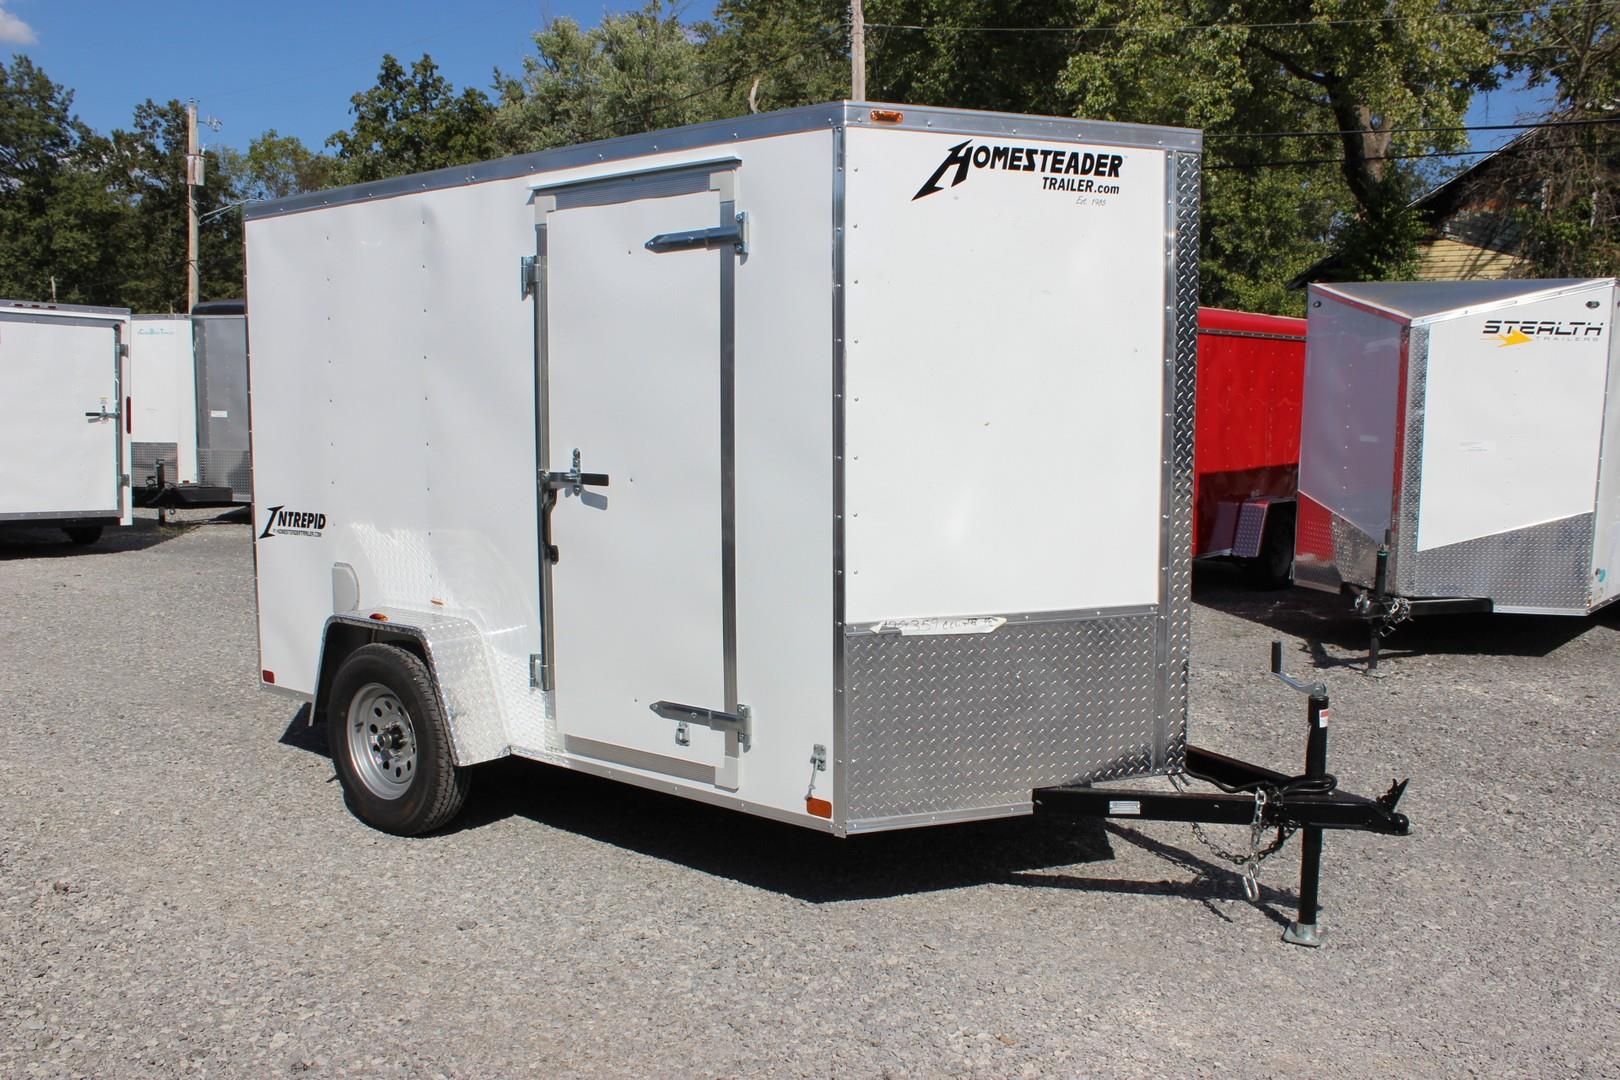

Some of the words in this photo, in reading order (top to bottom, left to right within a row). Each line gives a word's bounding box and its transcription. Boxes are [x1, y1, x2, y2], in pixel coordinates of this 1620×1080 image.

[911, 139, 1123, 201] HOMESTEADER
[1042, 176, 1119, 194] TRAILER.com
[1482, 320, 1604, 336] STEALTH
[259, 505, 326, 539] INTREPID
